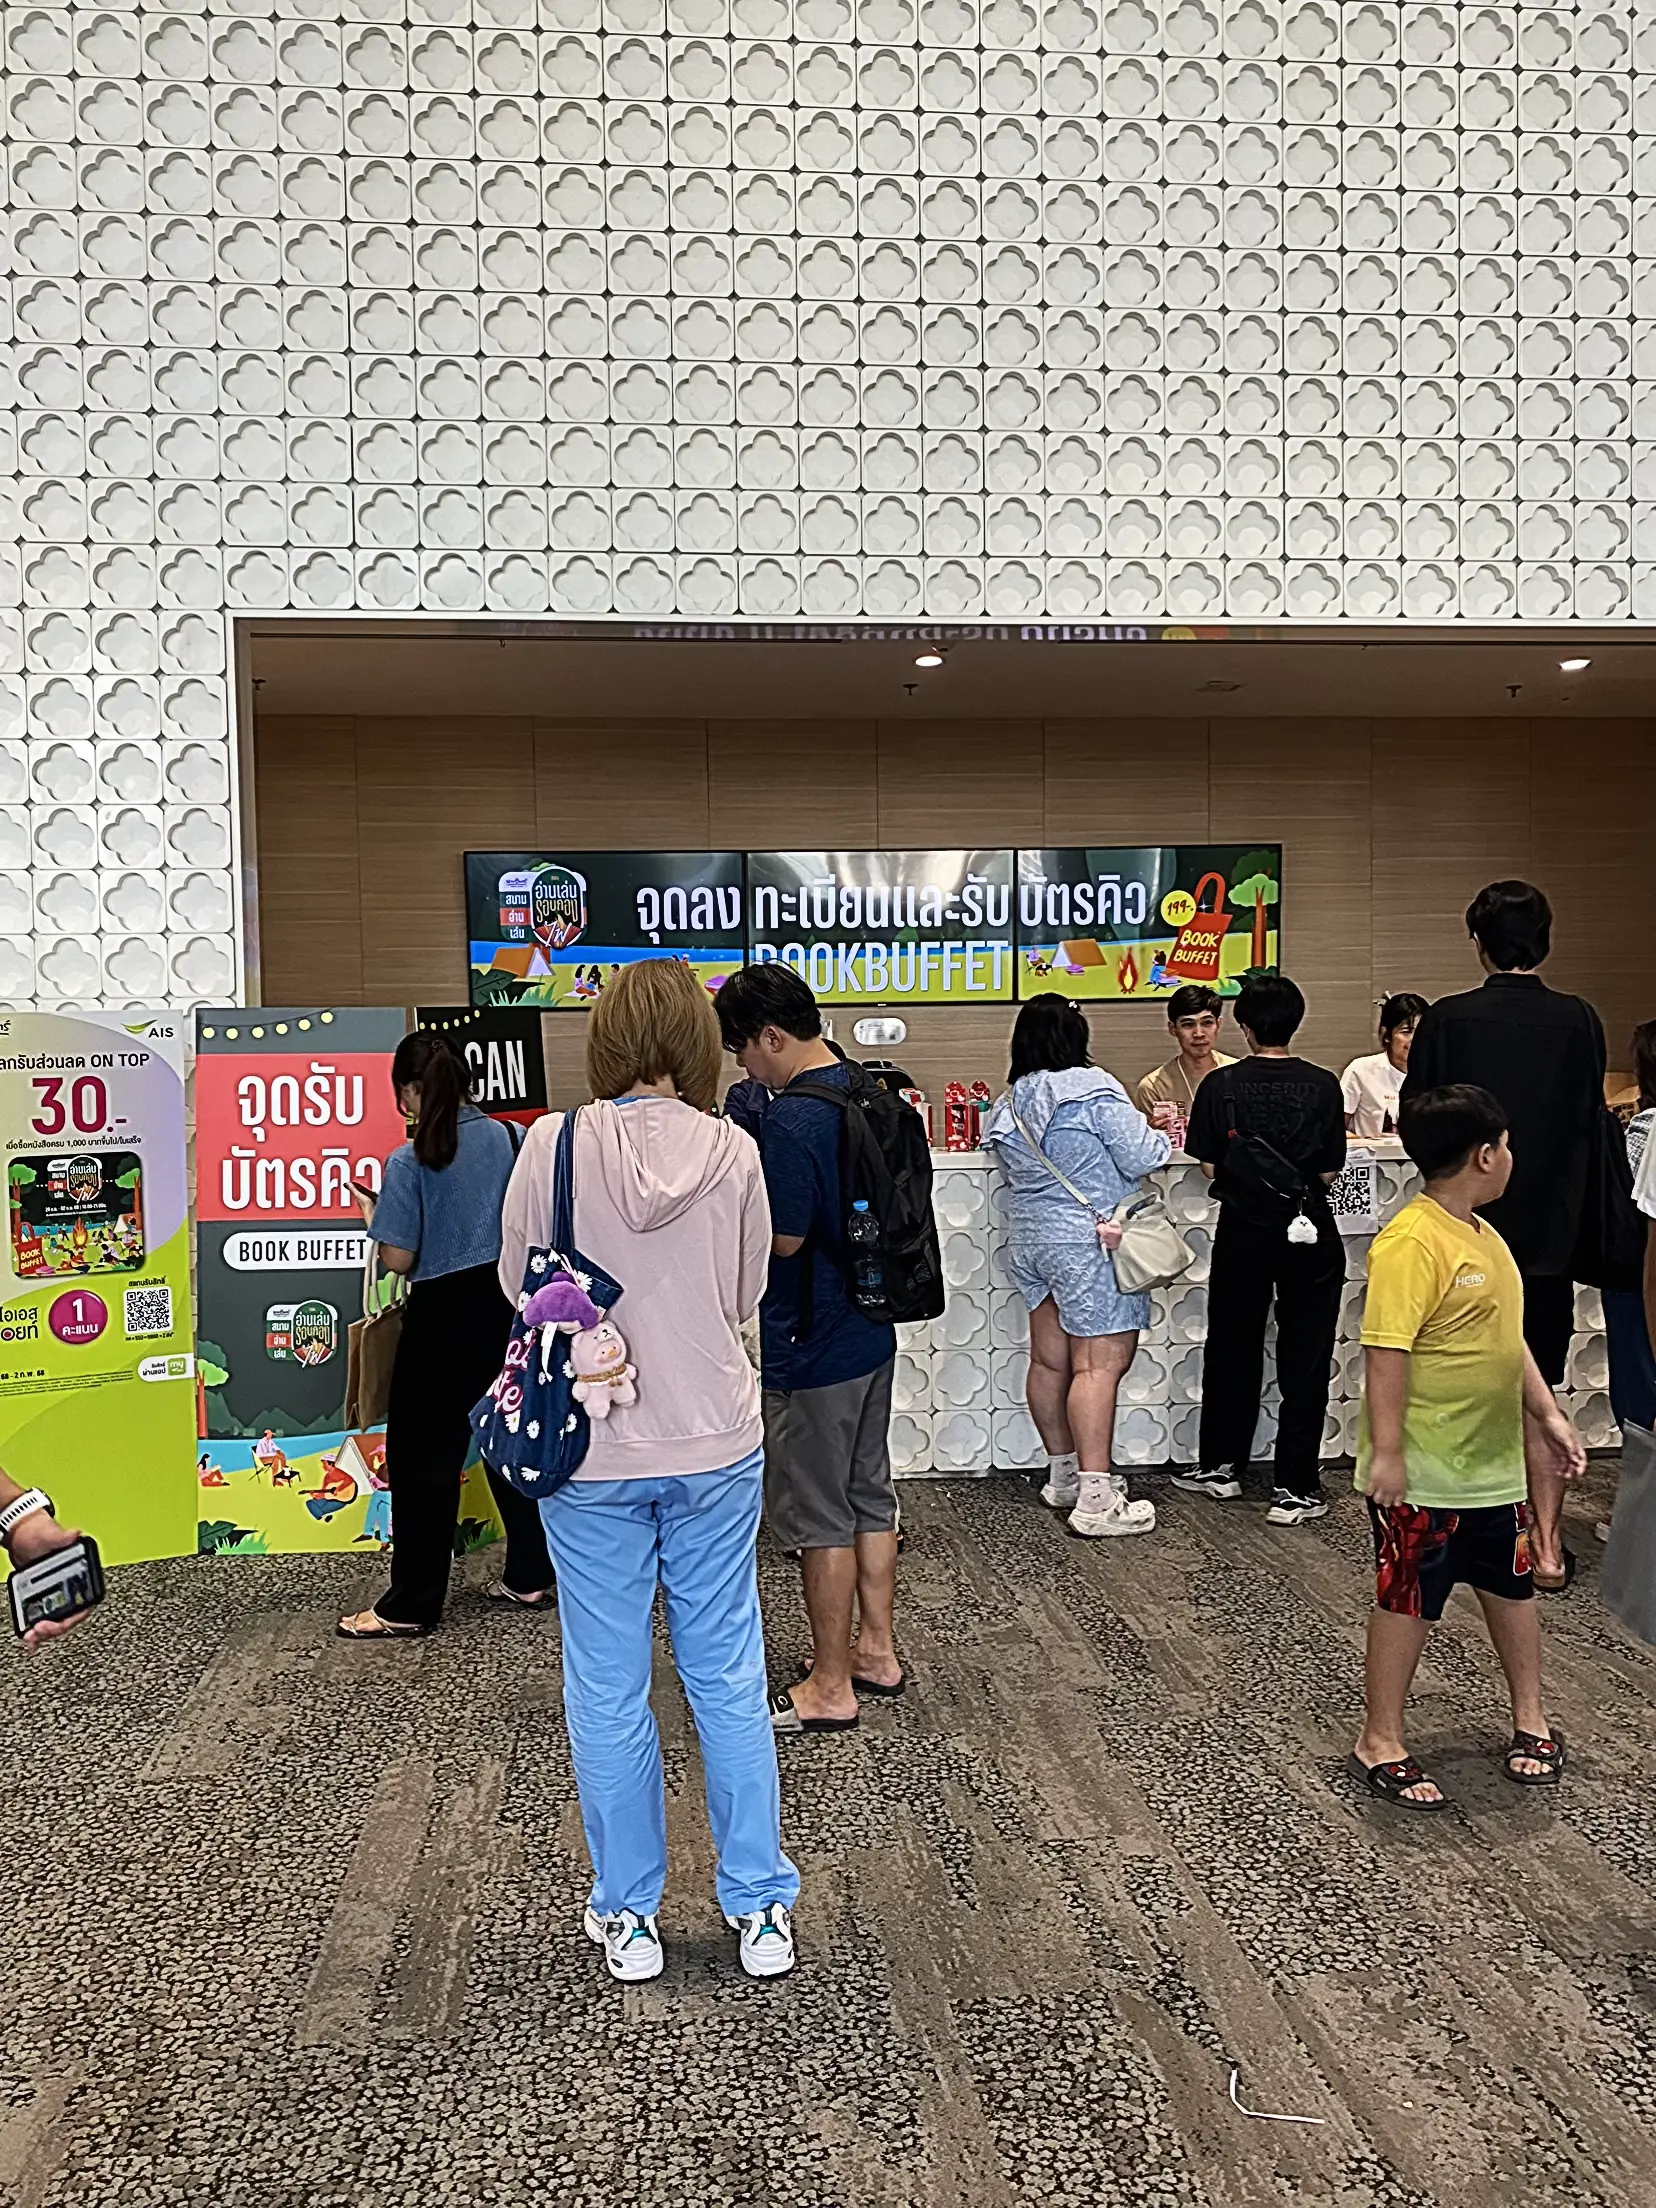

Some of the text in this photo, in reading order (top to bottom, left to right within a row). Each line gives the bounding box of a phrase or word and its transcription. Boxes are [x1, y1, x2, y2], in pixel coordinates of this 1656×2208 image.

[535, 880, 578, 899] อ่านเล่น
[636, 873, 1147, 945] จุดลง ทะเบียนและรับ บัตรคิว
[1180, 930, 1220, 947] BOOK
[1173, 949, 1218, 966] BUFFET
[148, 1027, 174, 1038] AIS
[91, 1054, 113, 1067] ON
[118, 1053, 150, 1067] TOP
[238, 1061, 364, 1143] จุดรับ
[67, 1139, 86, 1147] 1,000
[221, 1145, 383, 1210] บัตรคิว
[20, 1248, 41, 1261] BOOK
[239, 1239, 366, 1262] BOOK BUFFET
[1455, 1273, 1486, 1288] HERO
[72, 1298, 83, 1322] 1
[295, 1311, 330, 1326] อ่านเล่น
[62, 1323, 99, 1336] คะแนน
